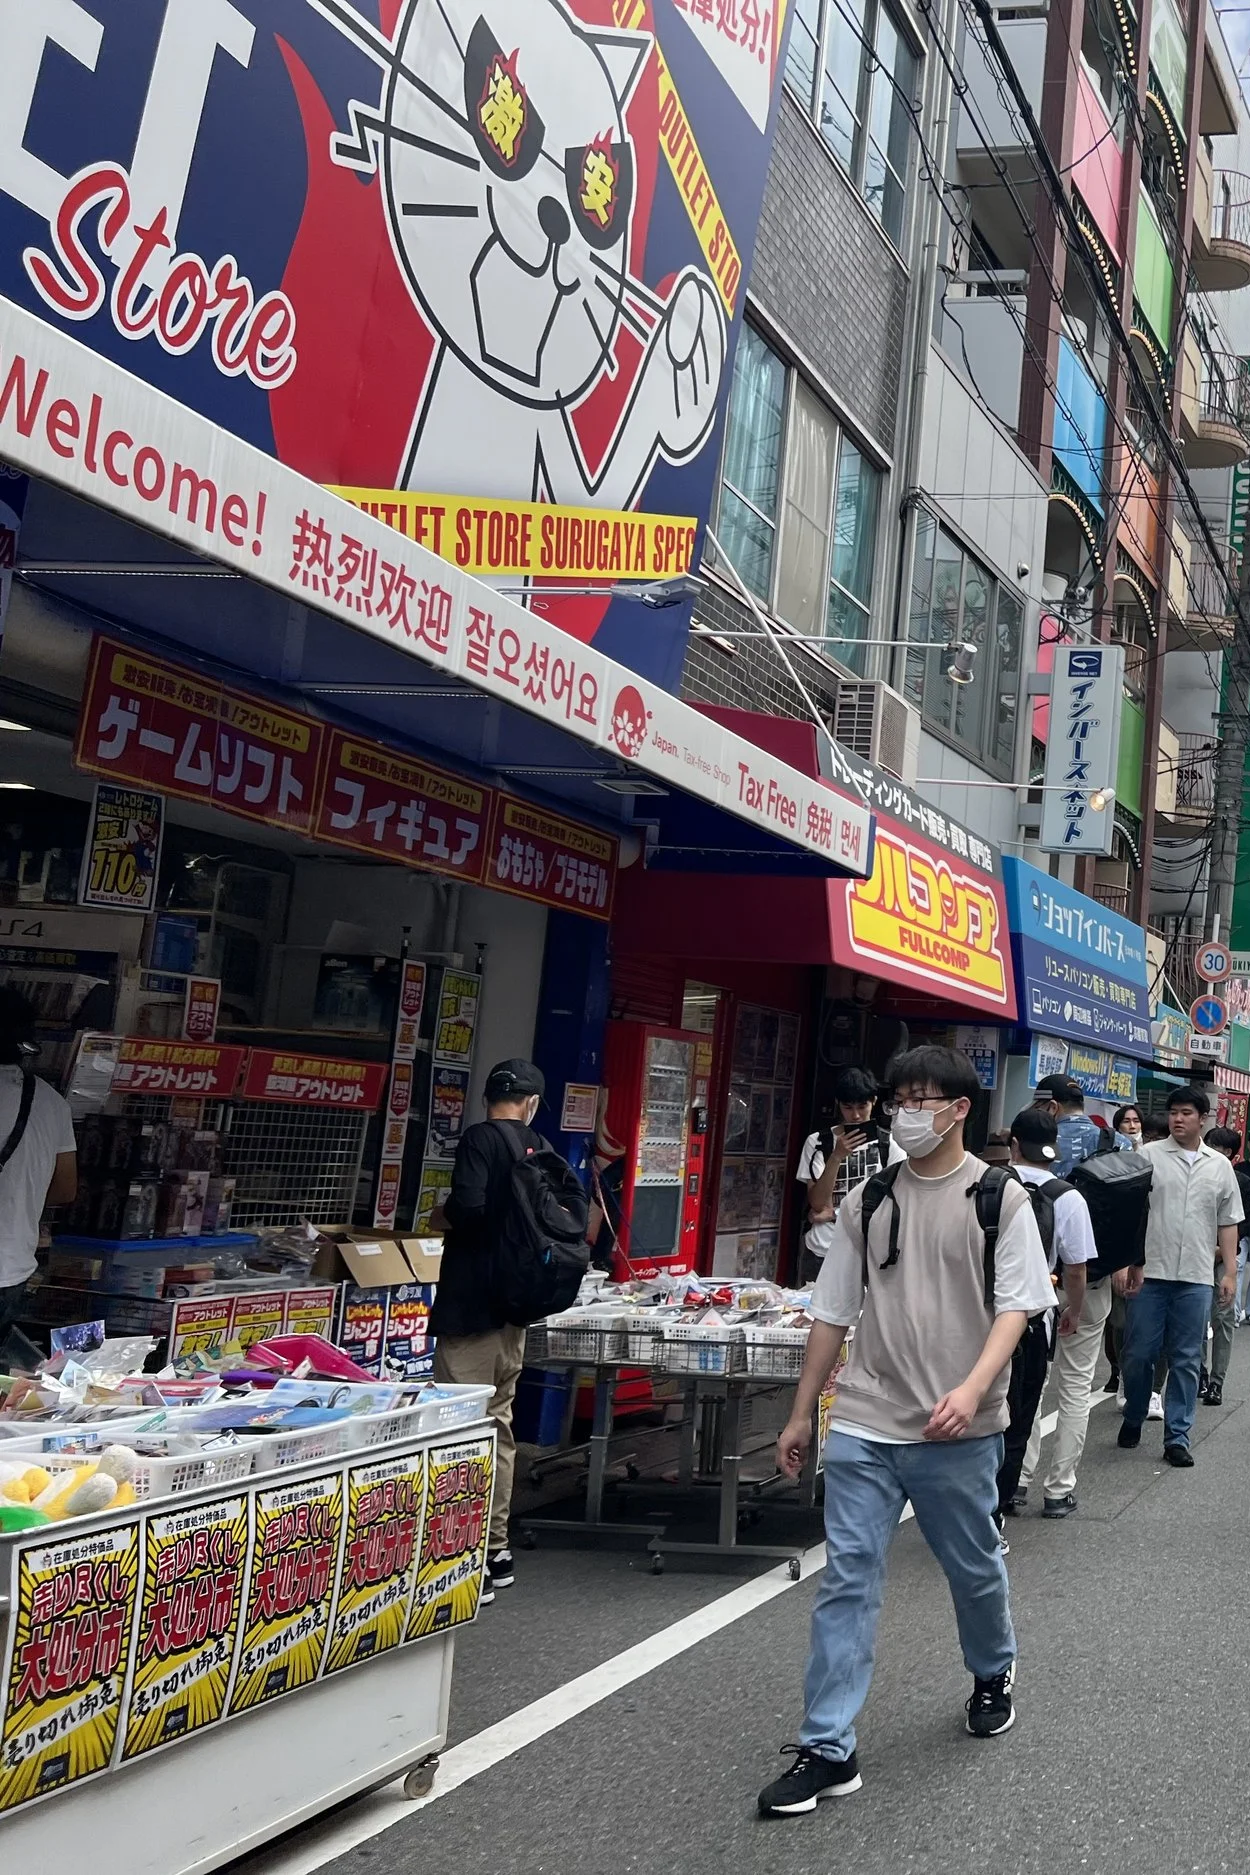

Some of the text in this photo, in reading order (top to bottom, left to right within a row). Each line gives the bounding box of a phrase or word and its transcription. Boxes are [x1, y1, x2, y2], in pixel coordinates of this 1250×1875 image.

[582, 153, 616, 229] 安
[659, 90, 740, 311] OUTLET STO
[27, 166, 297, 386] Store
[455, 507, 532, 568] STORE
[540, 515, 646, 573] SURUGAYA
[288, 508, 453, 656] 热烈欢迎
[464, 604, 600, 729] 잘오셨어요
[97, 695, 304, 815] ゲームソフト
[651, 730, 680, 760] Japan.
[713, 764, 731, 789] Shop
[1061, 680, 1100, 845] インバースネット
[330, 777, 479, 866] フィギュア
[737, 761, 797, 829] Tax Free
[805, 801, 832, 850] 免税
[841, 819, 861, 863] 면세
[899, 926, 971, 971] FULLCOMP
[1204, 954, 1225, 972] 30
[1190, 1038, 1222, 1051] 自動車
[343, 1319, 383, 1342] ジャンク
[387, 1315, 429, 1339] ジャンク
[263, 1503, 336, 1555] 売り尽くし
[357, 1480, 418, 1528] 売り尽くし
[156, 1529, 240, 1585] 売り尽くし
[250, 1540, 334, 1623] 大処分市
[344, 1514, 417, 1589] 大処分市
[31, 1562, 129, 1627] 売り尽くし
[143, 1567, 238, 1663] 大処分市
[16, 1603, 126, 1708] 大処分市
[241, 1605, 327, 1677] 売り切れ御免
[134, 1640, 230, 1719] 売り切れ御免
[3, 1680, 117, 1770] 売り切れ御免
